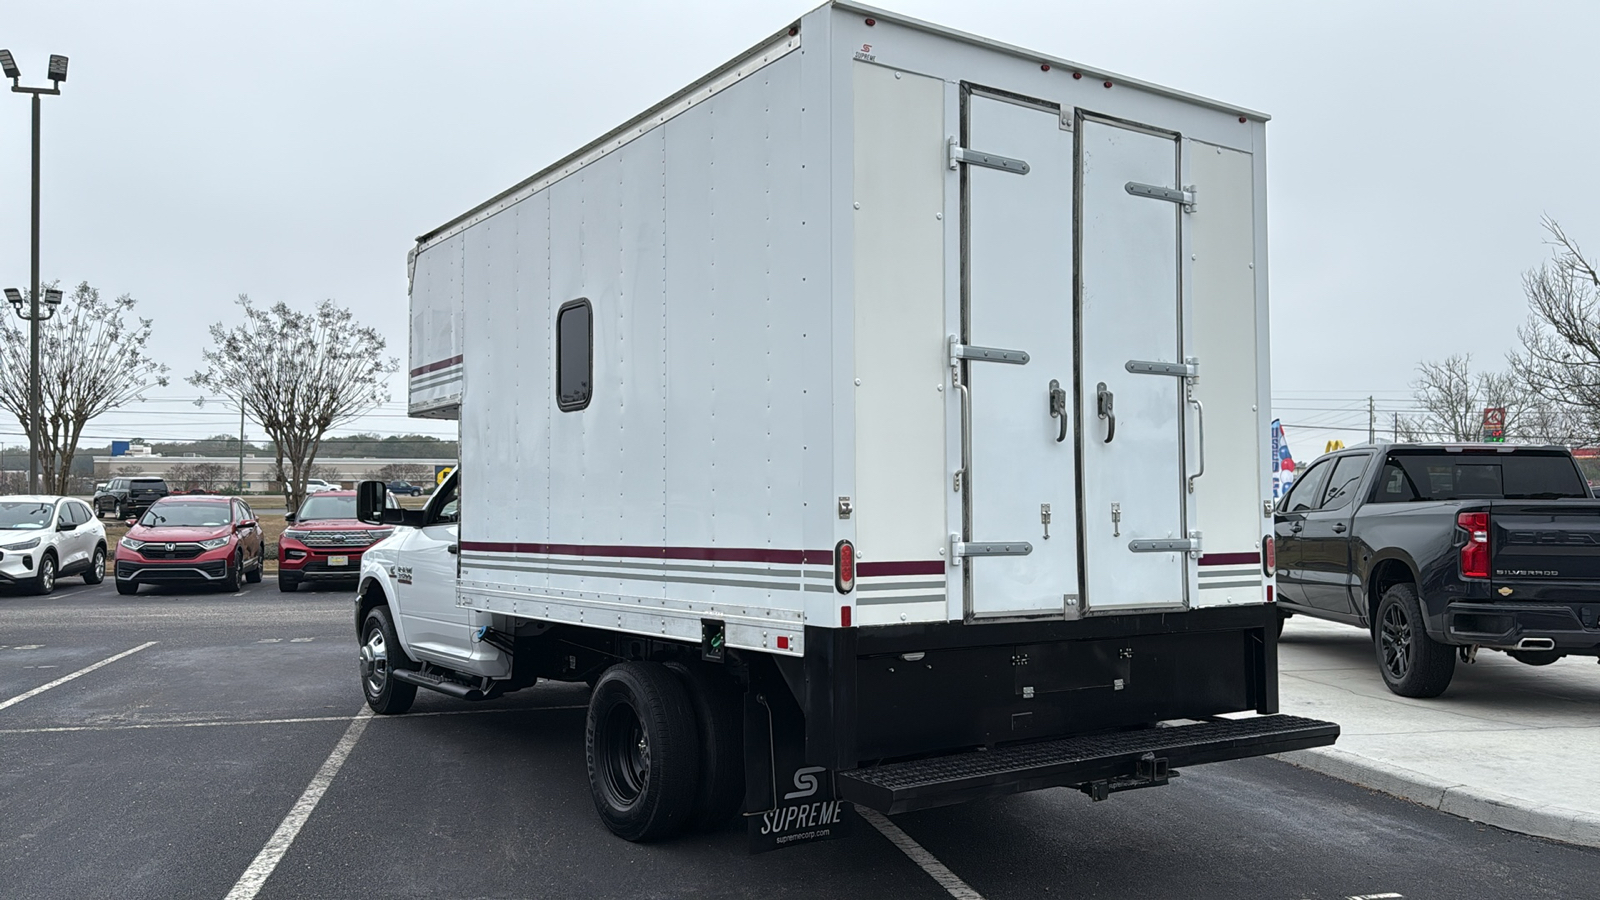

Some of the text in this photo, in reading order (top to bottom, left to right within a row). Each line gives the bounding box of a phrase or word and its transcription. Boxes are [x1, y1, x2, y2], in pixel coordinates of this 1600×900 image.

[855, 52, 876, 62] SUPREME
[761, 800, 844, 835] SUPREME
[776, 828, 830, 844] supremecorp.com
